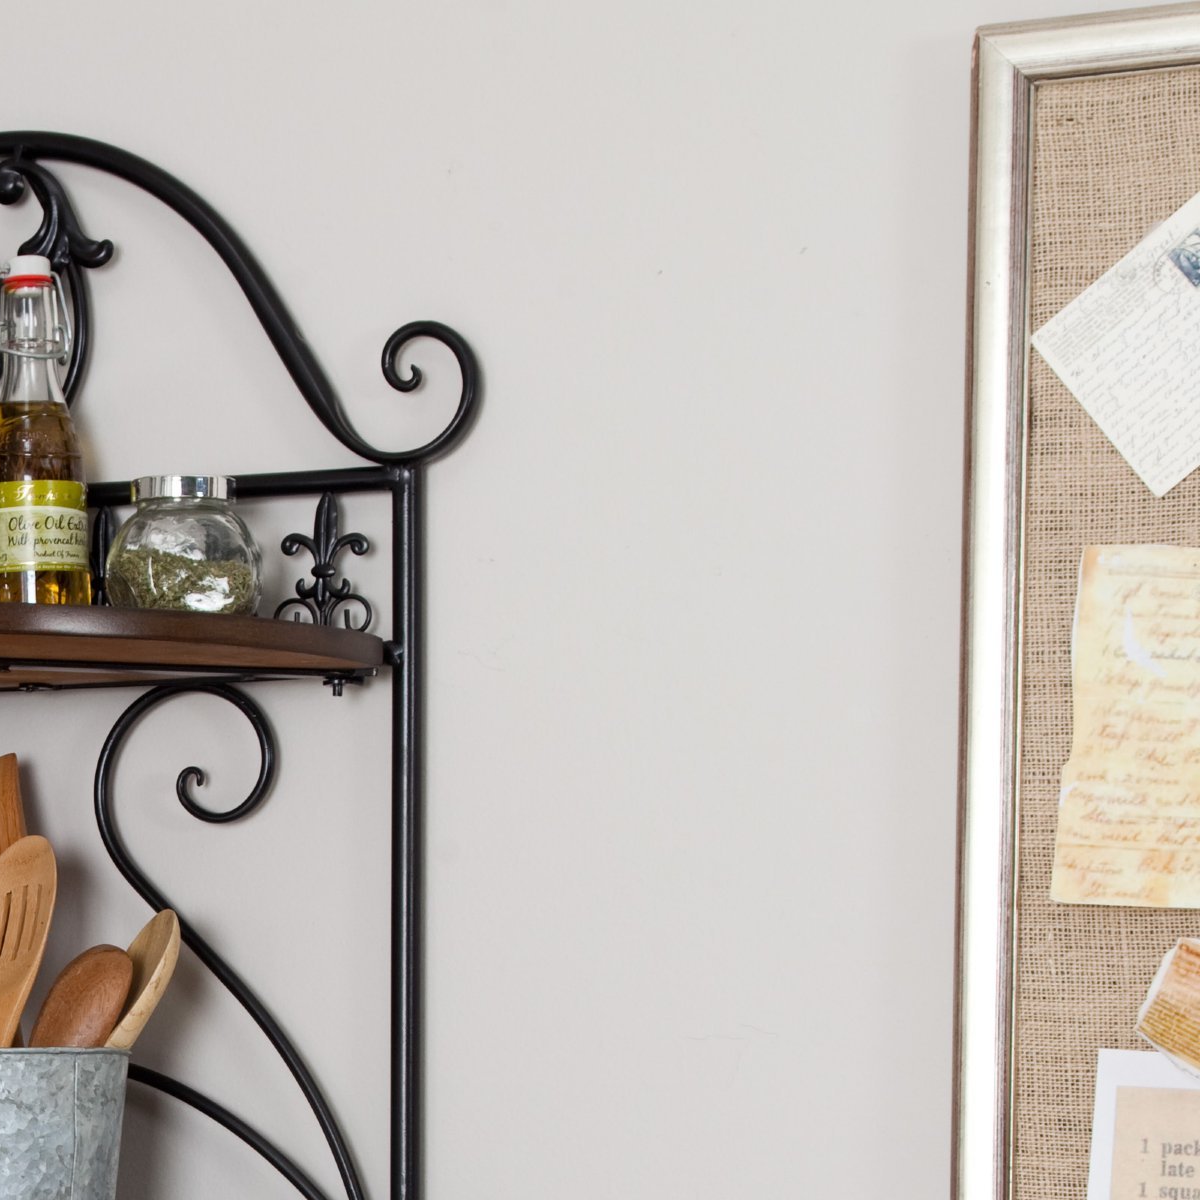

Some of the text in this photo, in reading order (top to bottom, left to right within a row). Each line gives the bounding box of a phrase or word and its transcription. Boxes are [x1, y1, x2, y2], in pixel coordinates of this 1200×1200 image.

[8, 515, 41, 531] Olie
[45, 514, 64, 530] Oil
[1139, 1138, 1149, 1153] 1
[1138, 1181, 1148, 1198] 1
